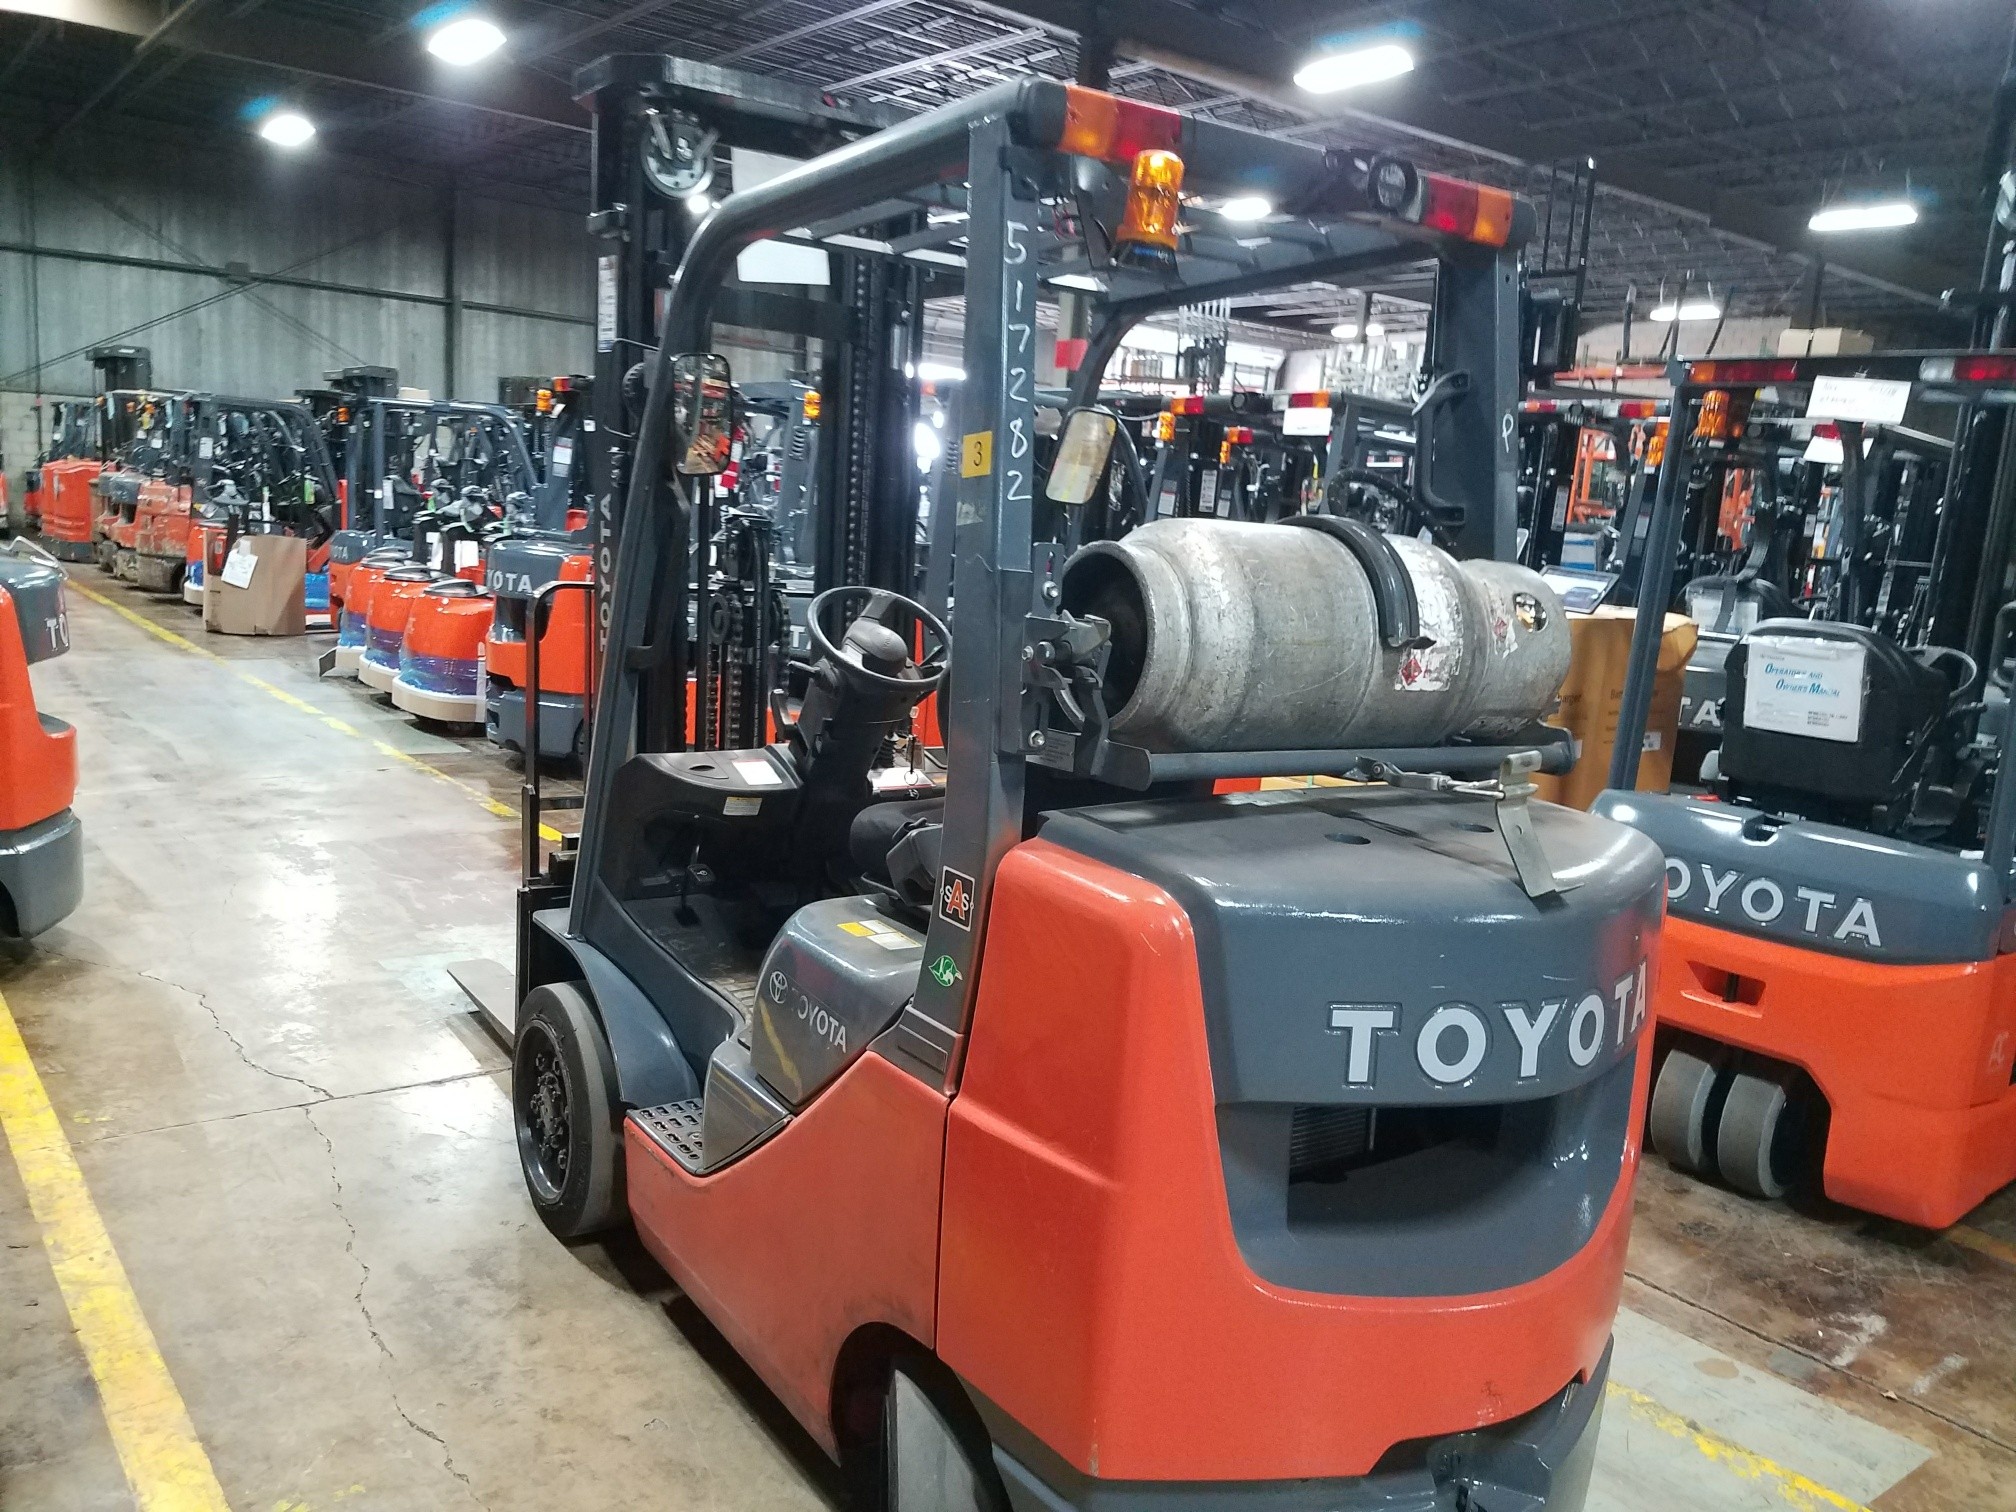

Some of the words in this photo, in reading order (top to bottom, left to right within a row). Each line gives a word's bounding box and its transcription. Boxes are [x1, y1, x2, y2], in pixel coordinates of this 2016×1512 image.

[973, 441, 983, 467] 3
[600, 493, 612, 652] TOYOTA
[1331, 961, 1647, 1083] TOYOTA
